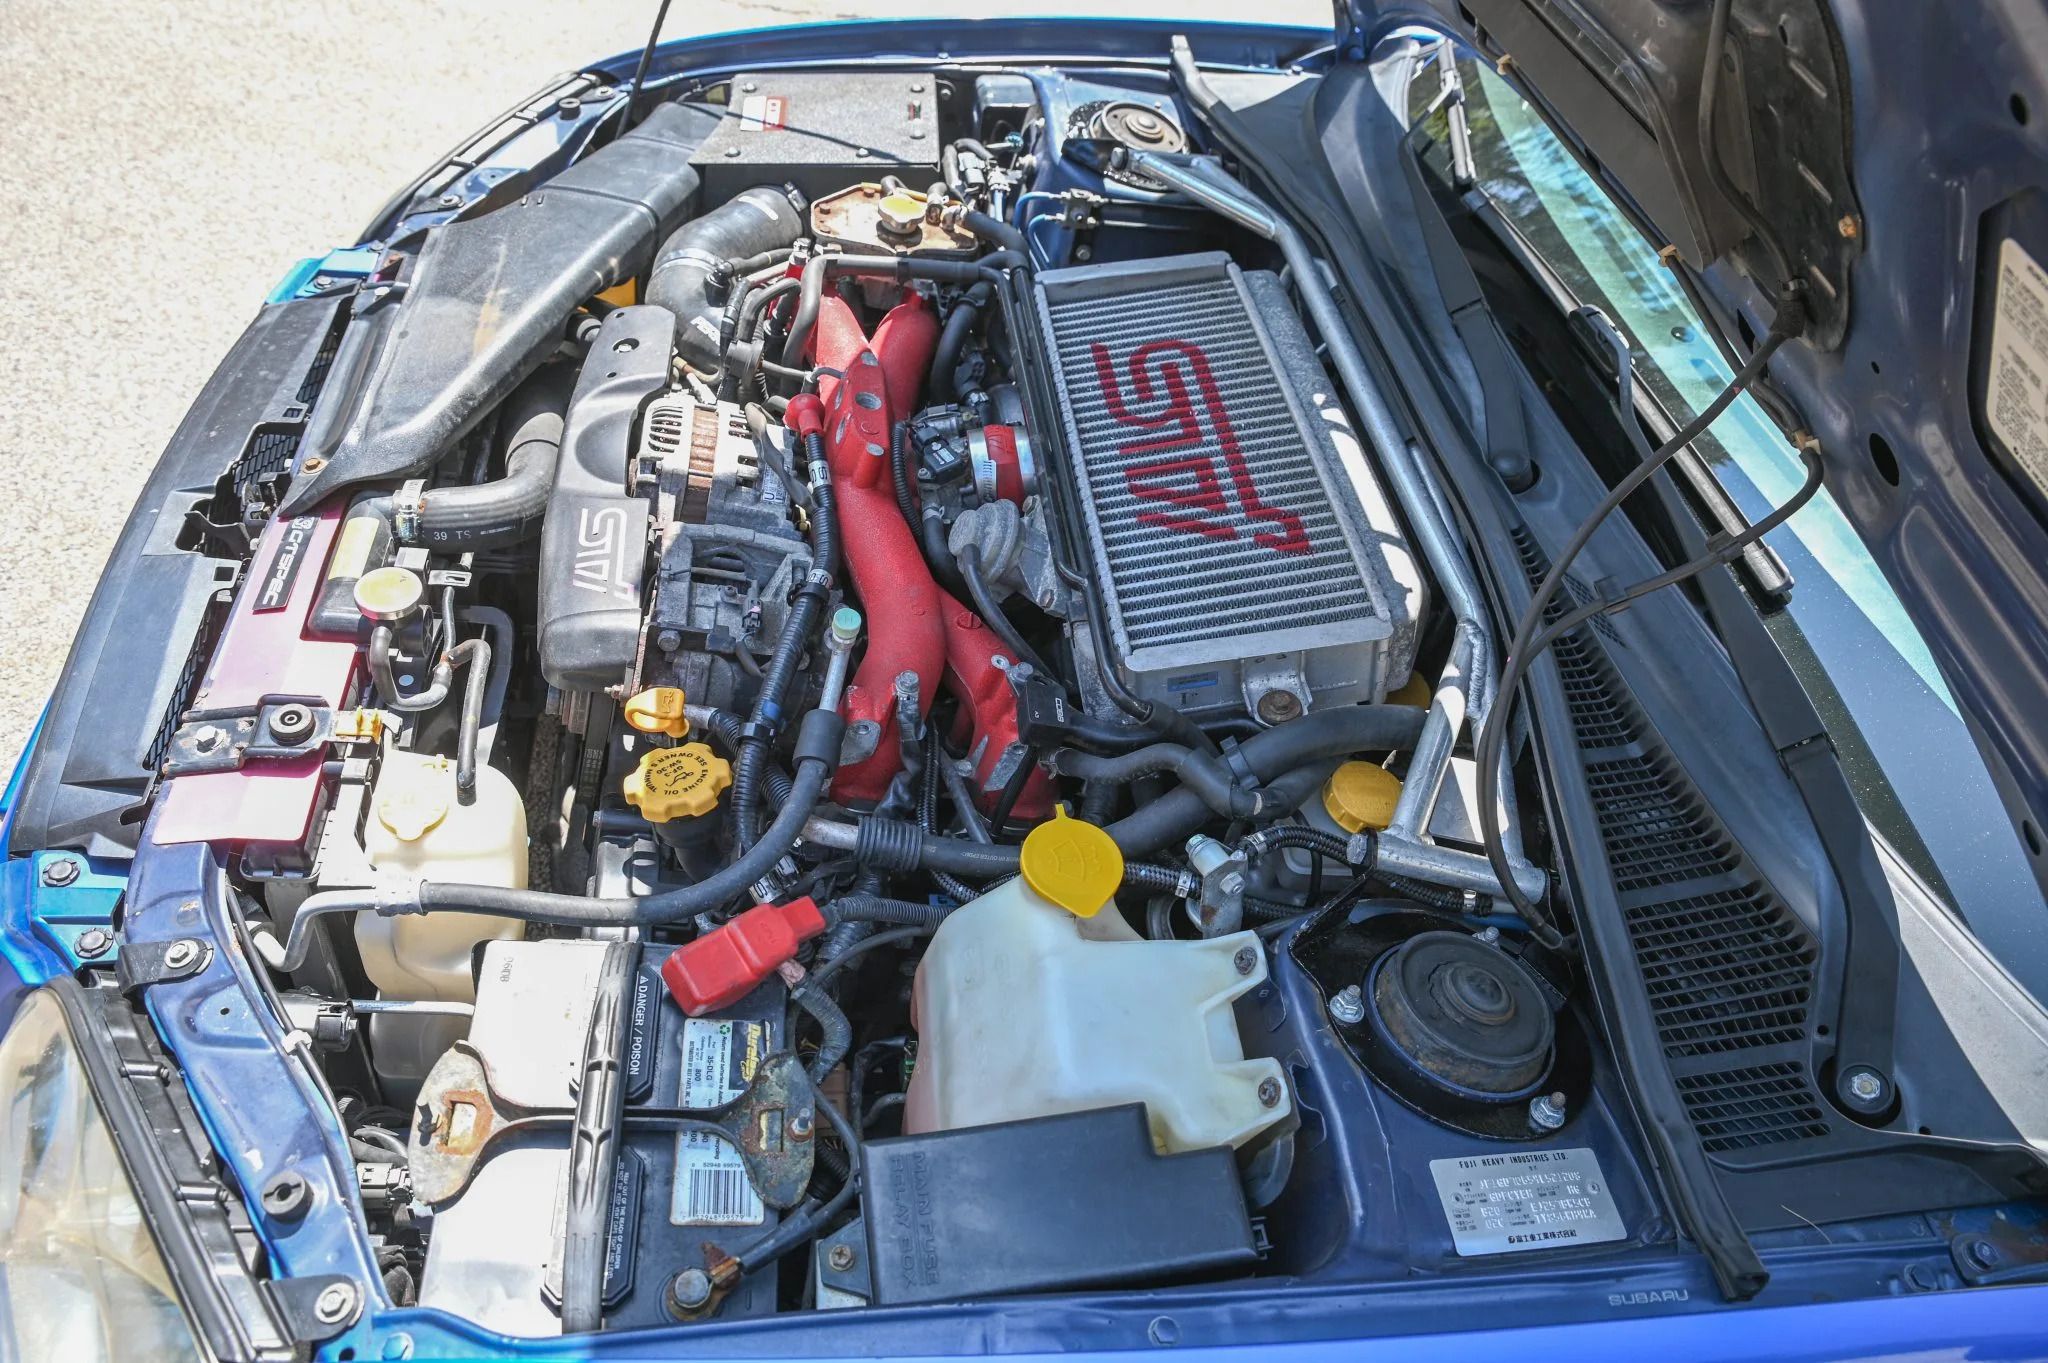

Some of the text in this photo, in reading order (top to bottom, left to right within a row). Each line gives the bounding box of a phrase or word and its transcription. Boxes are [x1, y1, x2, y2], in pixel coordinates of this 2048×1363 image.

[1055, 697, 1065, 723] COBB
[656, 759, 682, 775] 5W-30
[664, 765, 684, 778] GF-3
[694, 755, 708, 767] SEE
[644, 768, 658, 794] MANUAL
[682, 769, 709, 793] ENGINE
[635, 985, 648, 1026] DANGER
[629, 1036, 643, 1076] POISON
[706, 1055, 714, 1081] 35-DLG
[694, 1068, 702, 1082] 800
[1459, 1159, 1477, 1169] FUJI
[1482, 1157, 1505, 1168] HEAVY
[1510, 1154, 1550, 1165] INDUSTRIES
[890, 1157, 917, 1289] RELAY BOX
[913, 1151, 940, 1287] MAIN FUSE
[1608, 1288, 1689, 1307] SUBARU
